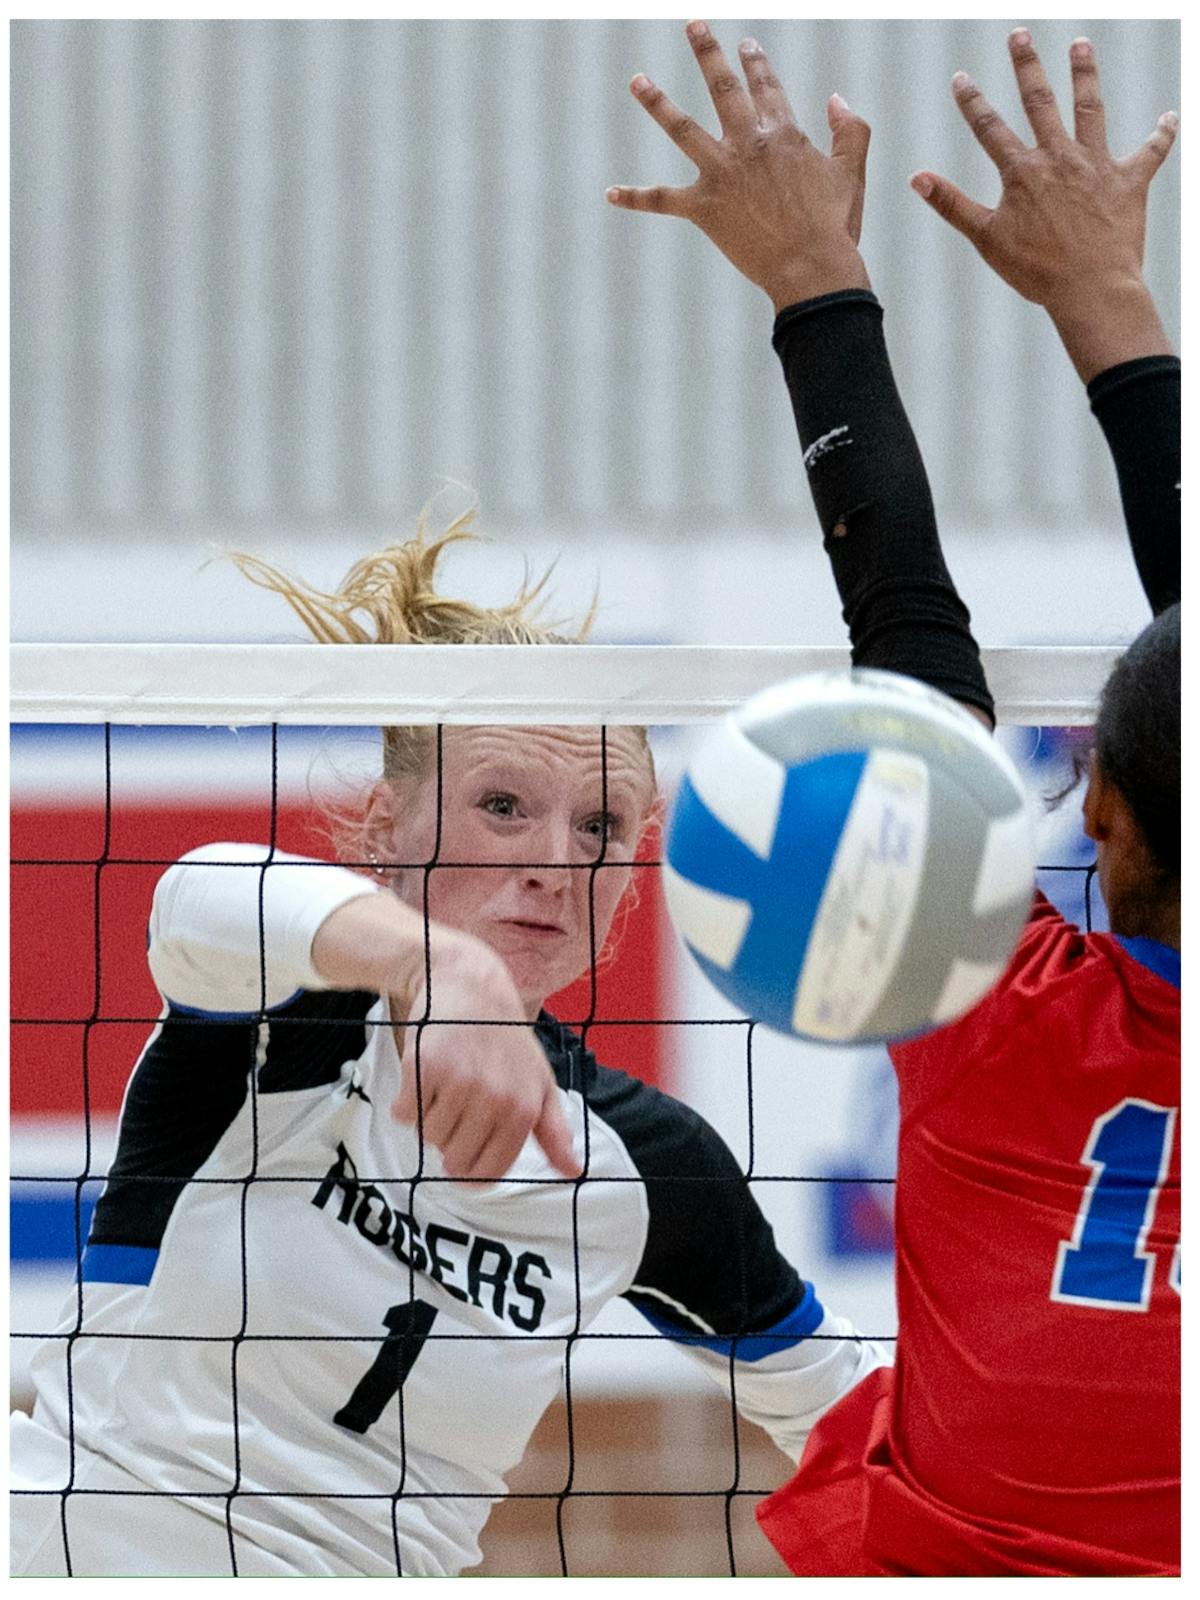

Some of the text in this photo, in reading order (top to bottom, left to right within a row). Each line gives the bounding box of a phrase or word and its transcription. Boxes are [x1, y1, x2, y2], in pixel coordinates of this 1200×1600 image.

[310, 1140, 552, 1333] ROGERS
[1050, 1097, 1181, 1312] 1
[333, 1299, 439, 1434] 1
